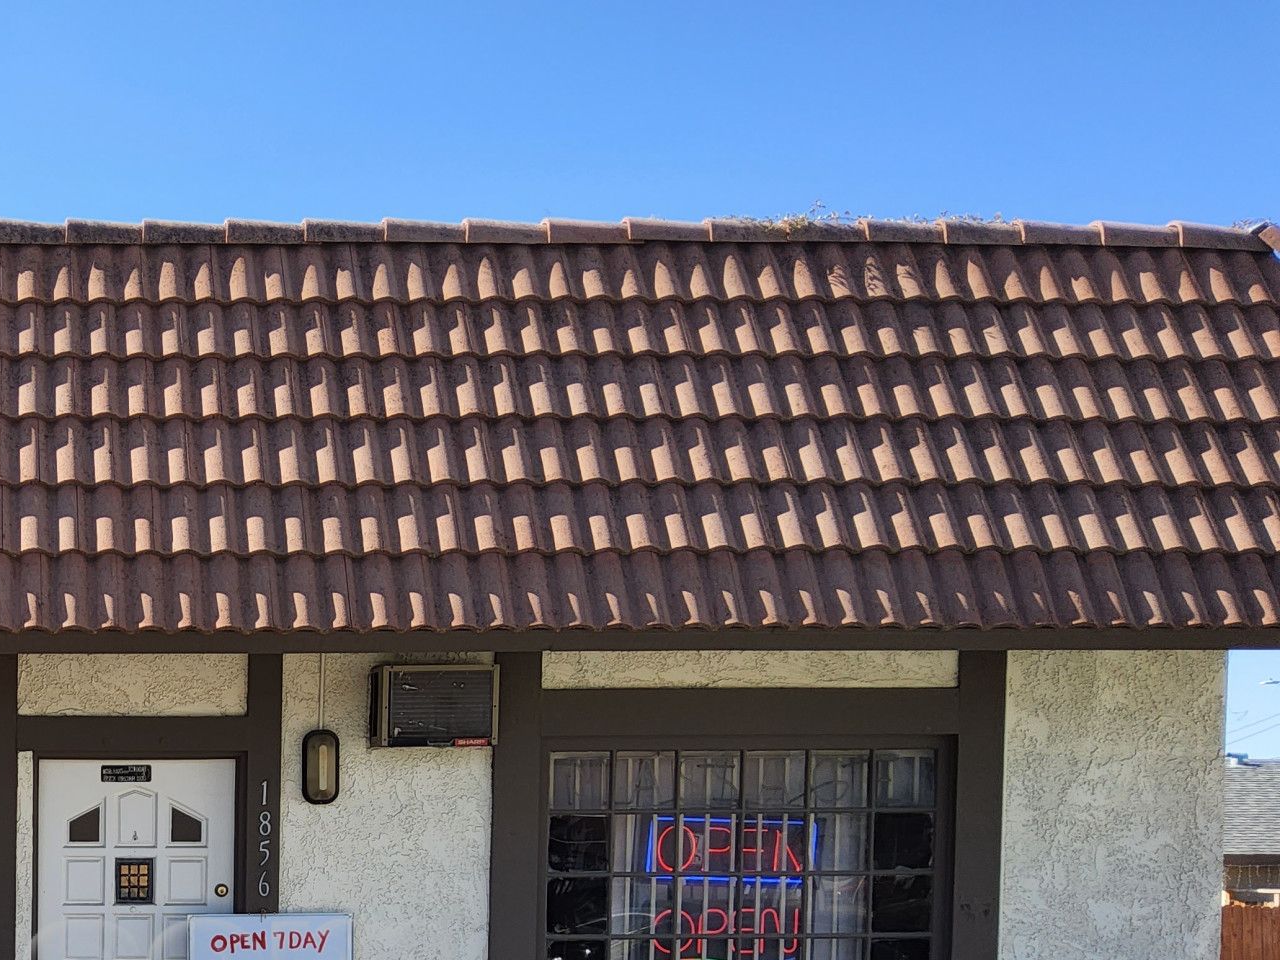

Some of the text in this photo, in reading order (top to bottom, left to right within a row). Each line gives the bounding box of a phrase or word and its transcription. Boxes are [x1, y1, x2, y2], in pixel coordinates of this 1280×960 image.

[259, 780, 272, 897] 1856
[657, 825, 803, 872] OPEN
[210, 930, 330, 953] OPEN 7 DAY
[652, 907, 800, 954] OPEN
